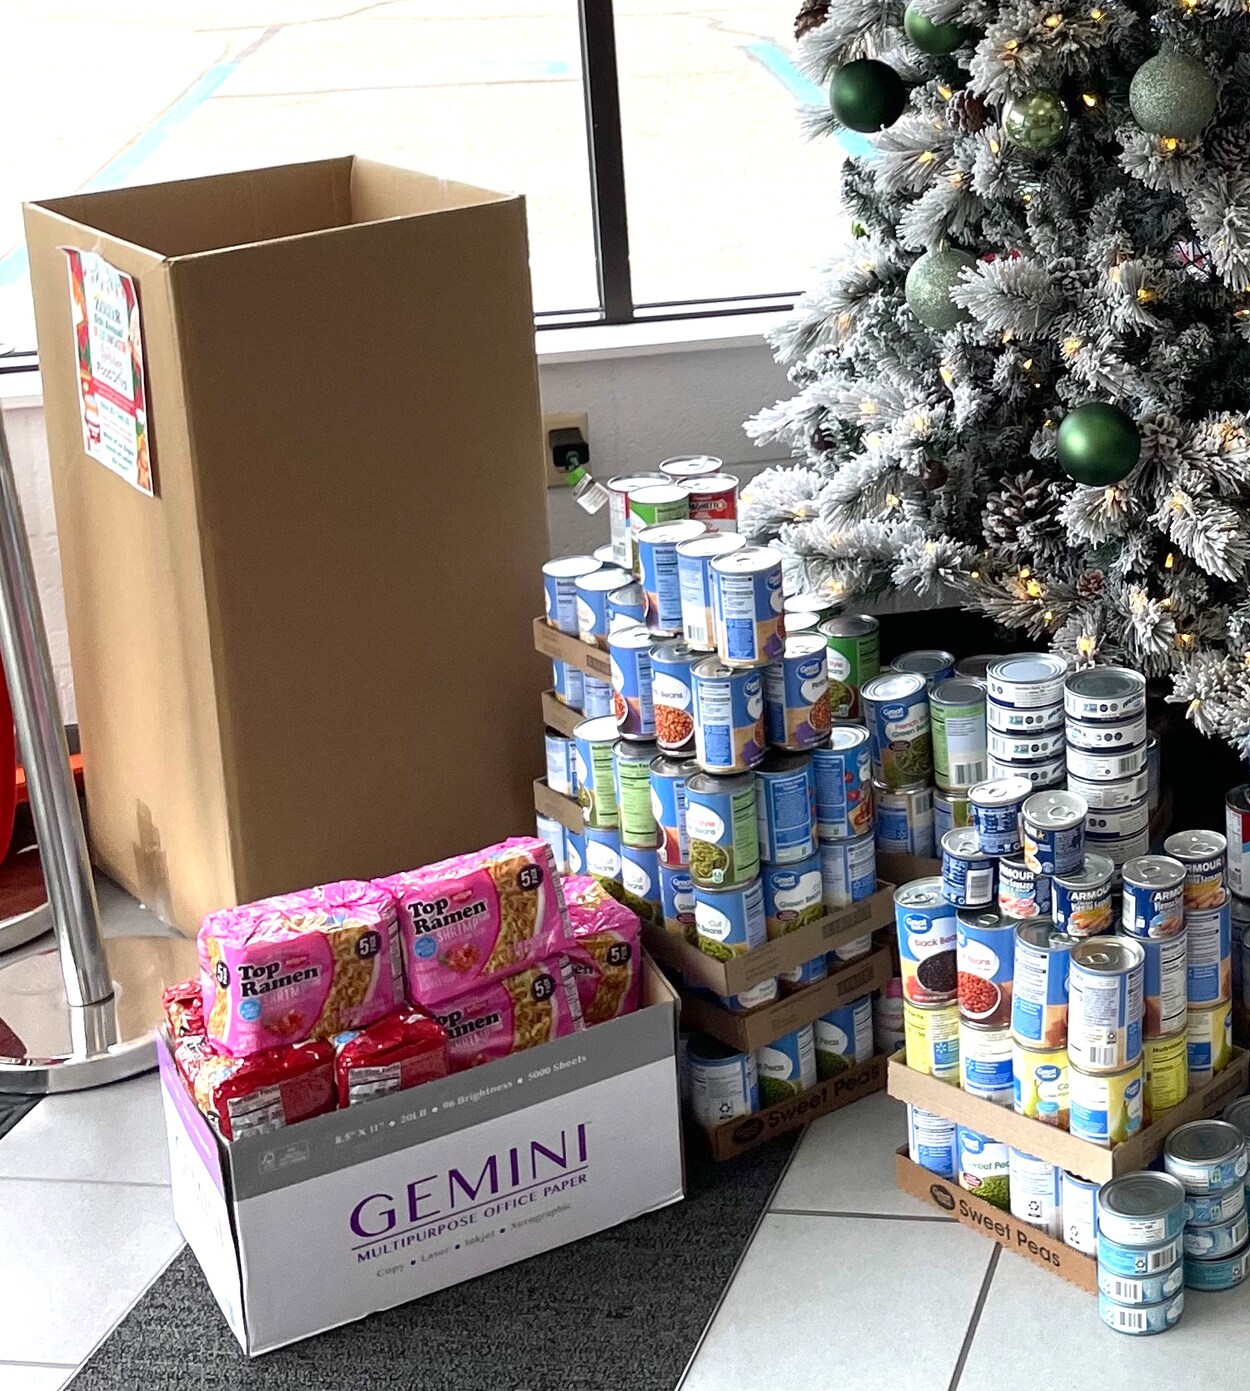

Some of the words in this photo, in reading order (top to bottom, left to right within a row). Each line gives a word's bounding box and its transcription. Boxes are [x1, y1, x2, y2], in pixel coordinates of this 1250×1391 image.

[1186, 858, 1222, 875] RMOUR
[521, 870, 531, 888] 5
[1069, 884, 1112, 902] ARMOU
[1154, 885, 1184, 902] ARMO
[408, 898, 449, 920] Top
[414, 901, 487, 935] Ramen
[709, 919, 723, 928] Cut
[359, 937, 370, 956] 5
[611, 944, 621, 963] 5
[238, 961, 281, 981] Top
[240, 966, 319, 997] Ramen
[535, 980, 545, 998] 5
[819, 1037, 840, 1047] Peas
[763, 1064, 785, 1072] Peas
[357, 1126, 368, 1138] X
[456, 1080, 514, 1106] Brightness
[526, 1066, 552, 1082] 5000
[552, 1054, 588, 1073] Sheets
[1057, 1082, 1069, 1091] Co
[768, 1088, 828, 1129] Sweet
[832, 1065, 880, 1098] Peas
[350, 1123, 588, 1239] GEMINI
[357, 1212, 479, 1264] MULTIPURPOSE
[483, 1192, 539, 1219] OFFICE
[543, 1173, 588, 1198] PAPER
[958, 1199, 1011, 1241] Sweet
[1016, 1229, 1061, 1268] Peas
[376, 1263, 406, 1279] Copy
[420, 1246, 451, 1262] Laser
[464, 1229, 497, 1248] Inkjet
